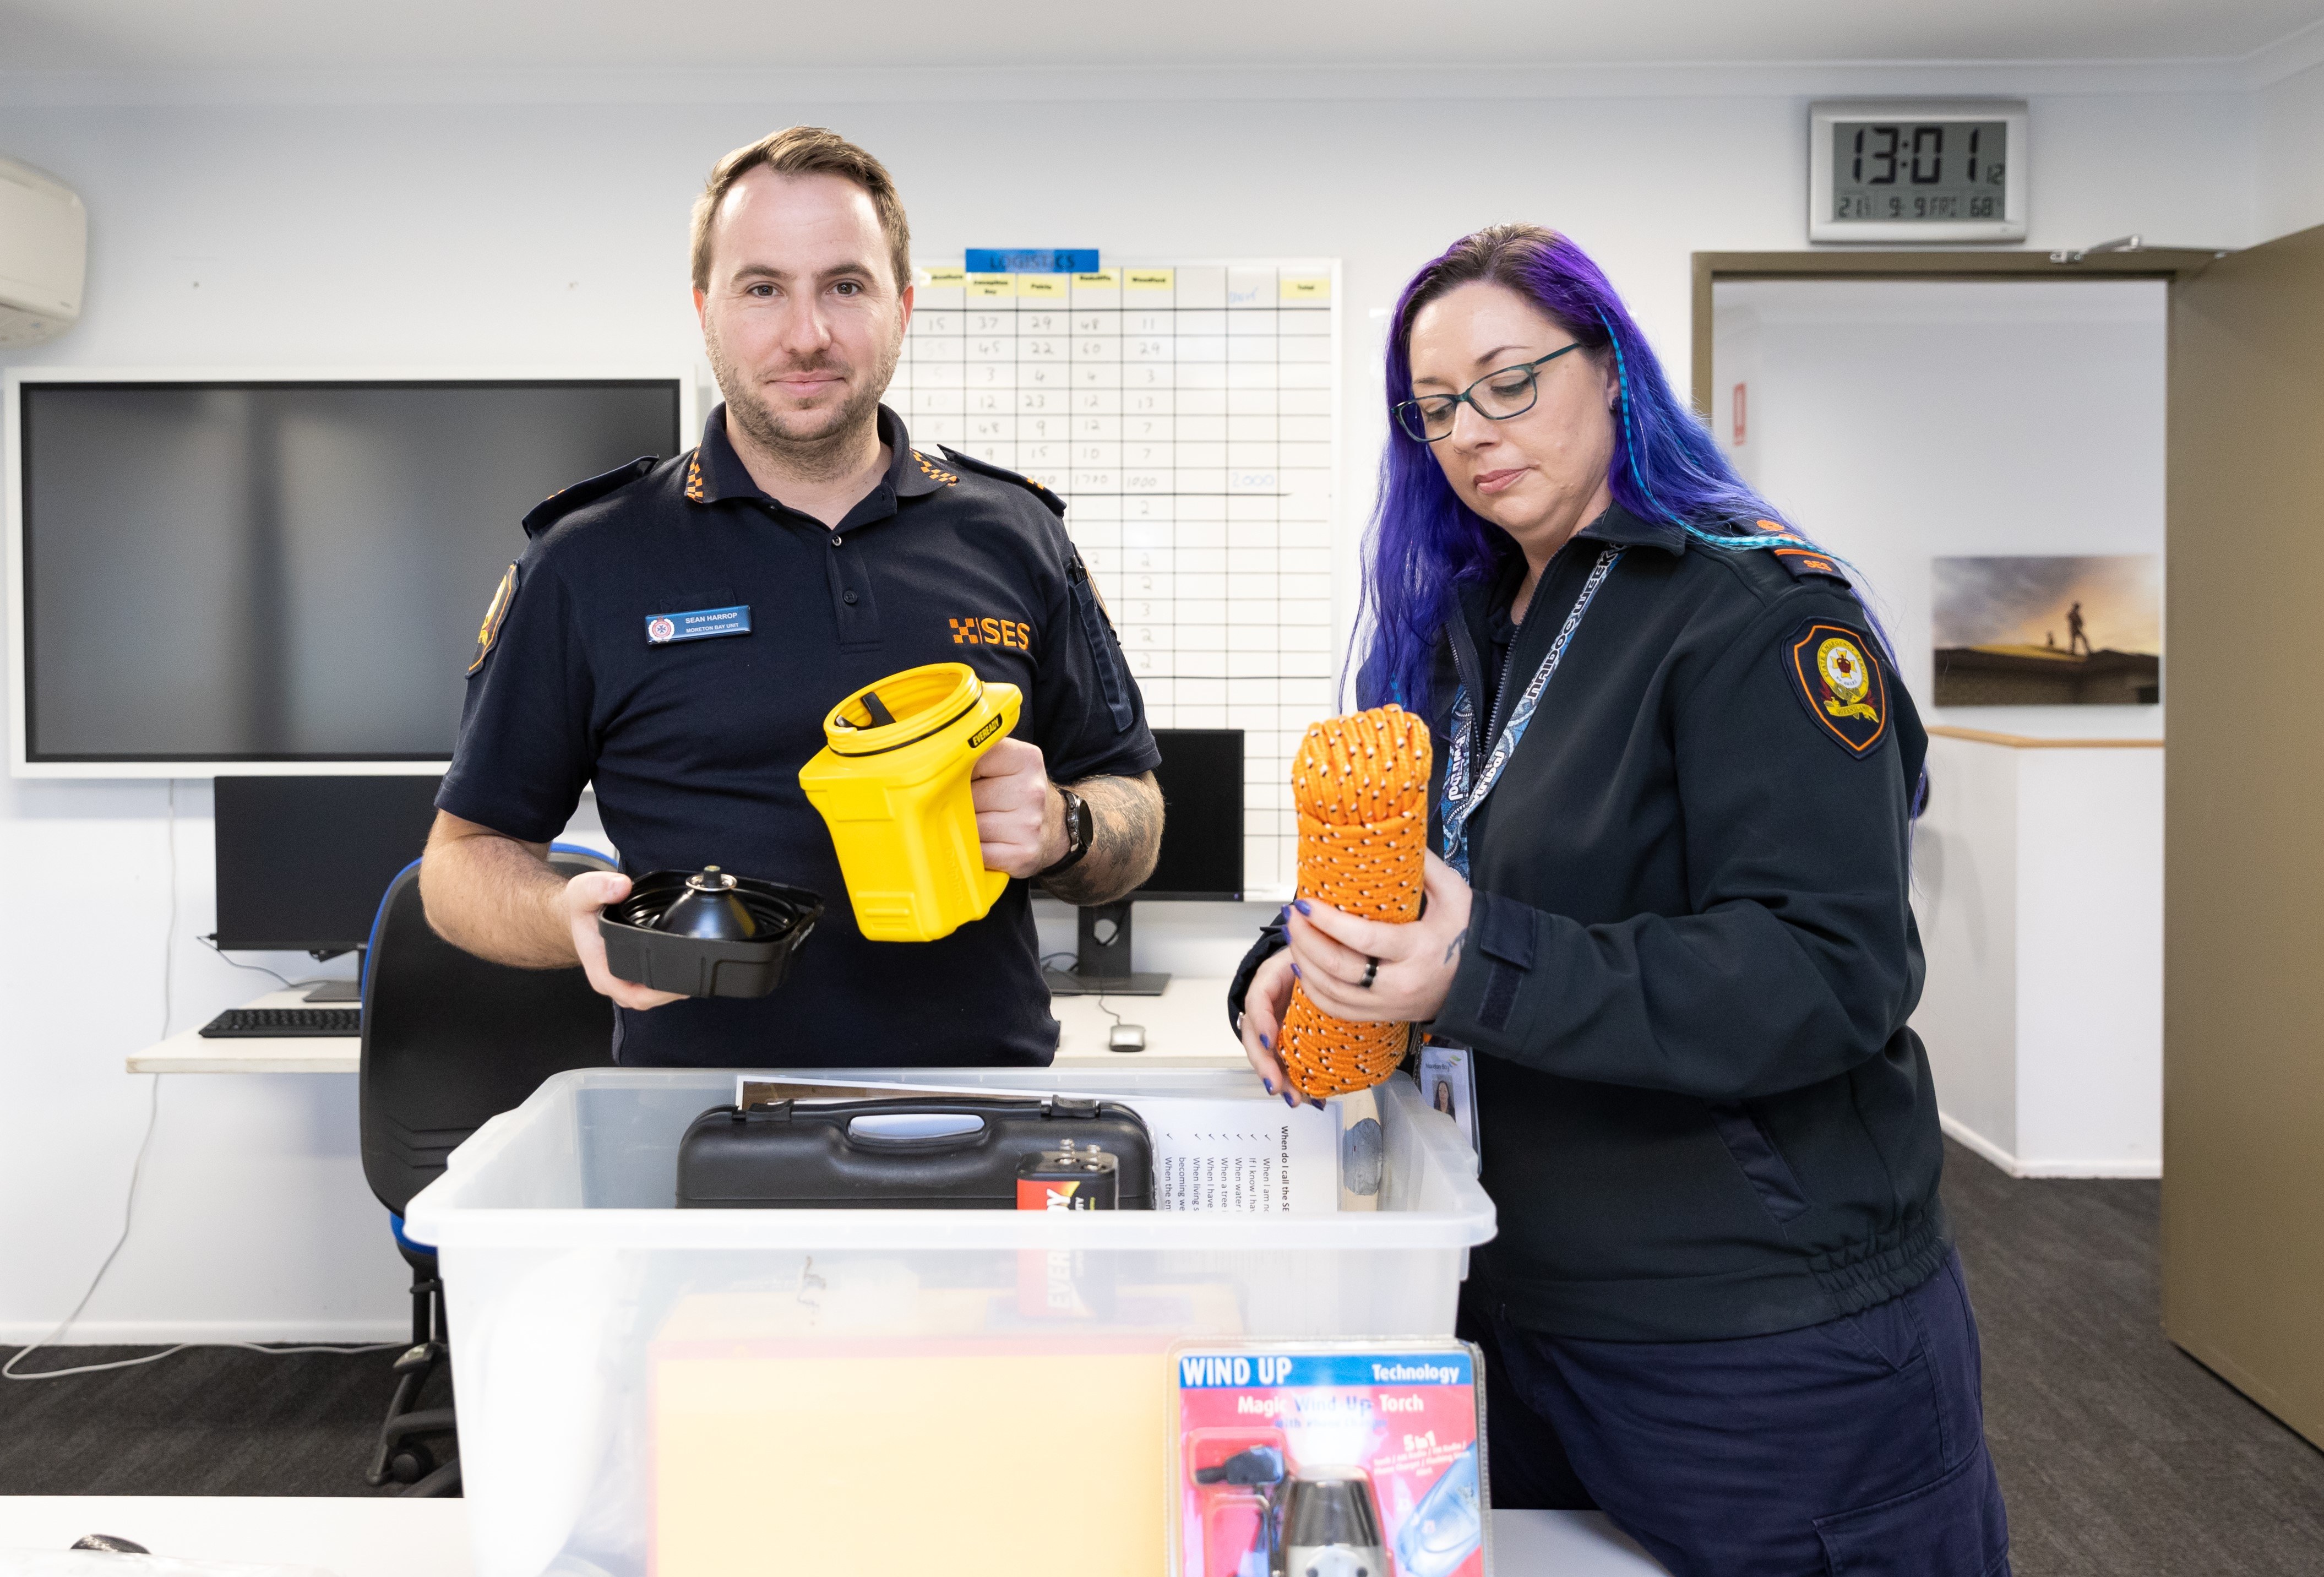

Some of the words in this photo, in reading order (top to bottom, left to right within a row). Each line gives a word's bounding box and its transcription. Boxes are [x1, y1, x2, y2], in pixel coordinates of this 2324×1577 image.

[1852, 127, 1979, 185] 13:01
[1803, 559, 1833, 572] SES
[1572, 551, 1619, 616] WEEK
[707, 612, 737, 621] HARROP
[981, 617, 1030, 651] SES
[972, 716, 1000, 747] EVEREADY
[1281, 1126, 1289, 1150] When
[1281, 1152, 1289, 1163] do
[1178, 1157, 1187, 1197] becoming
[1281, 1170, 1289, 1184] call
[1191, 1184, 1200, 1205] living
[1262, 1189, 1269, 1202] am
[1281, 1187, 1289, 1200] the
[1182, 1357, 1251, 1386] WIND
[1258, 1357, 1293, 1385] UP
[1371, 1363, 1460, 1384] Technology
[1237, 1395, 1287, 1417] Magic
[1379, 1394, 1424, 1413] Torch
